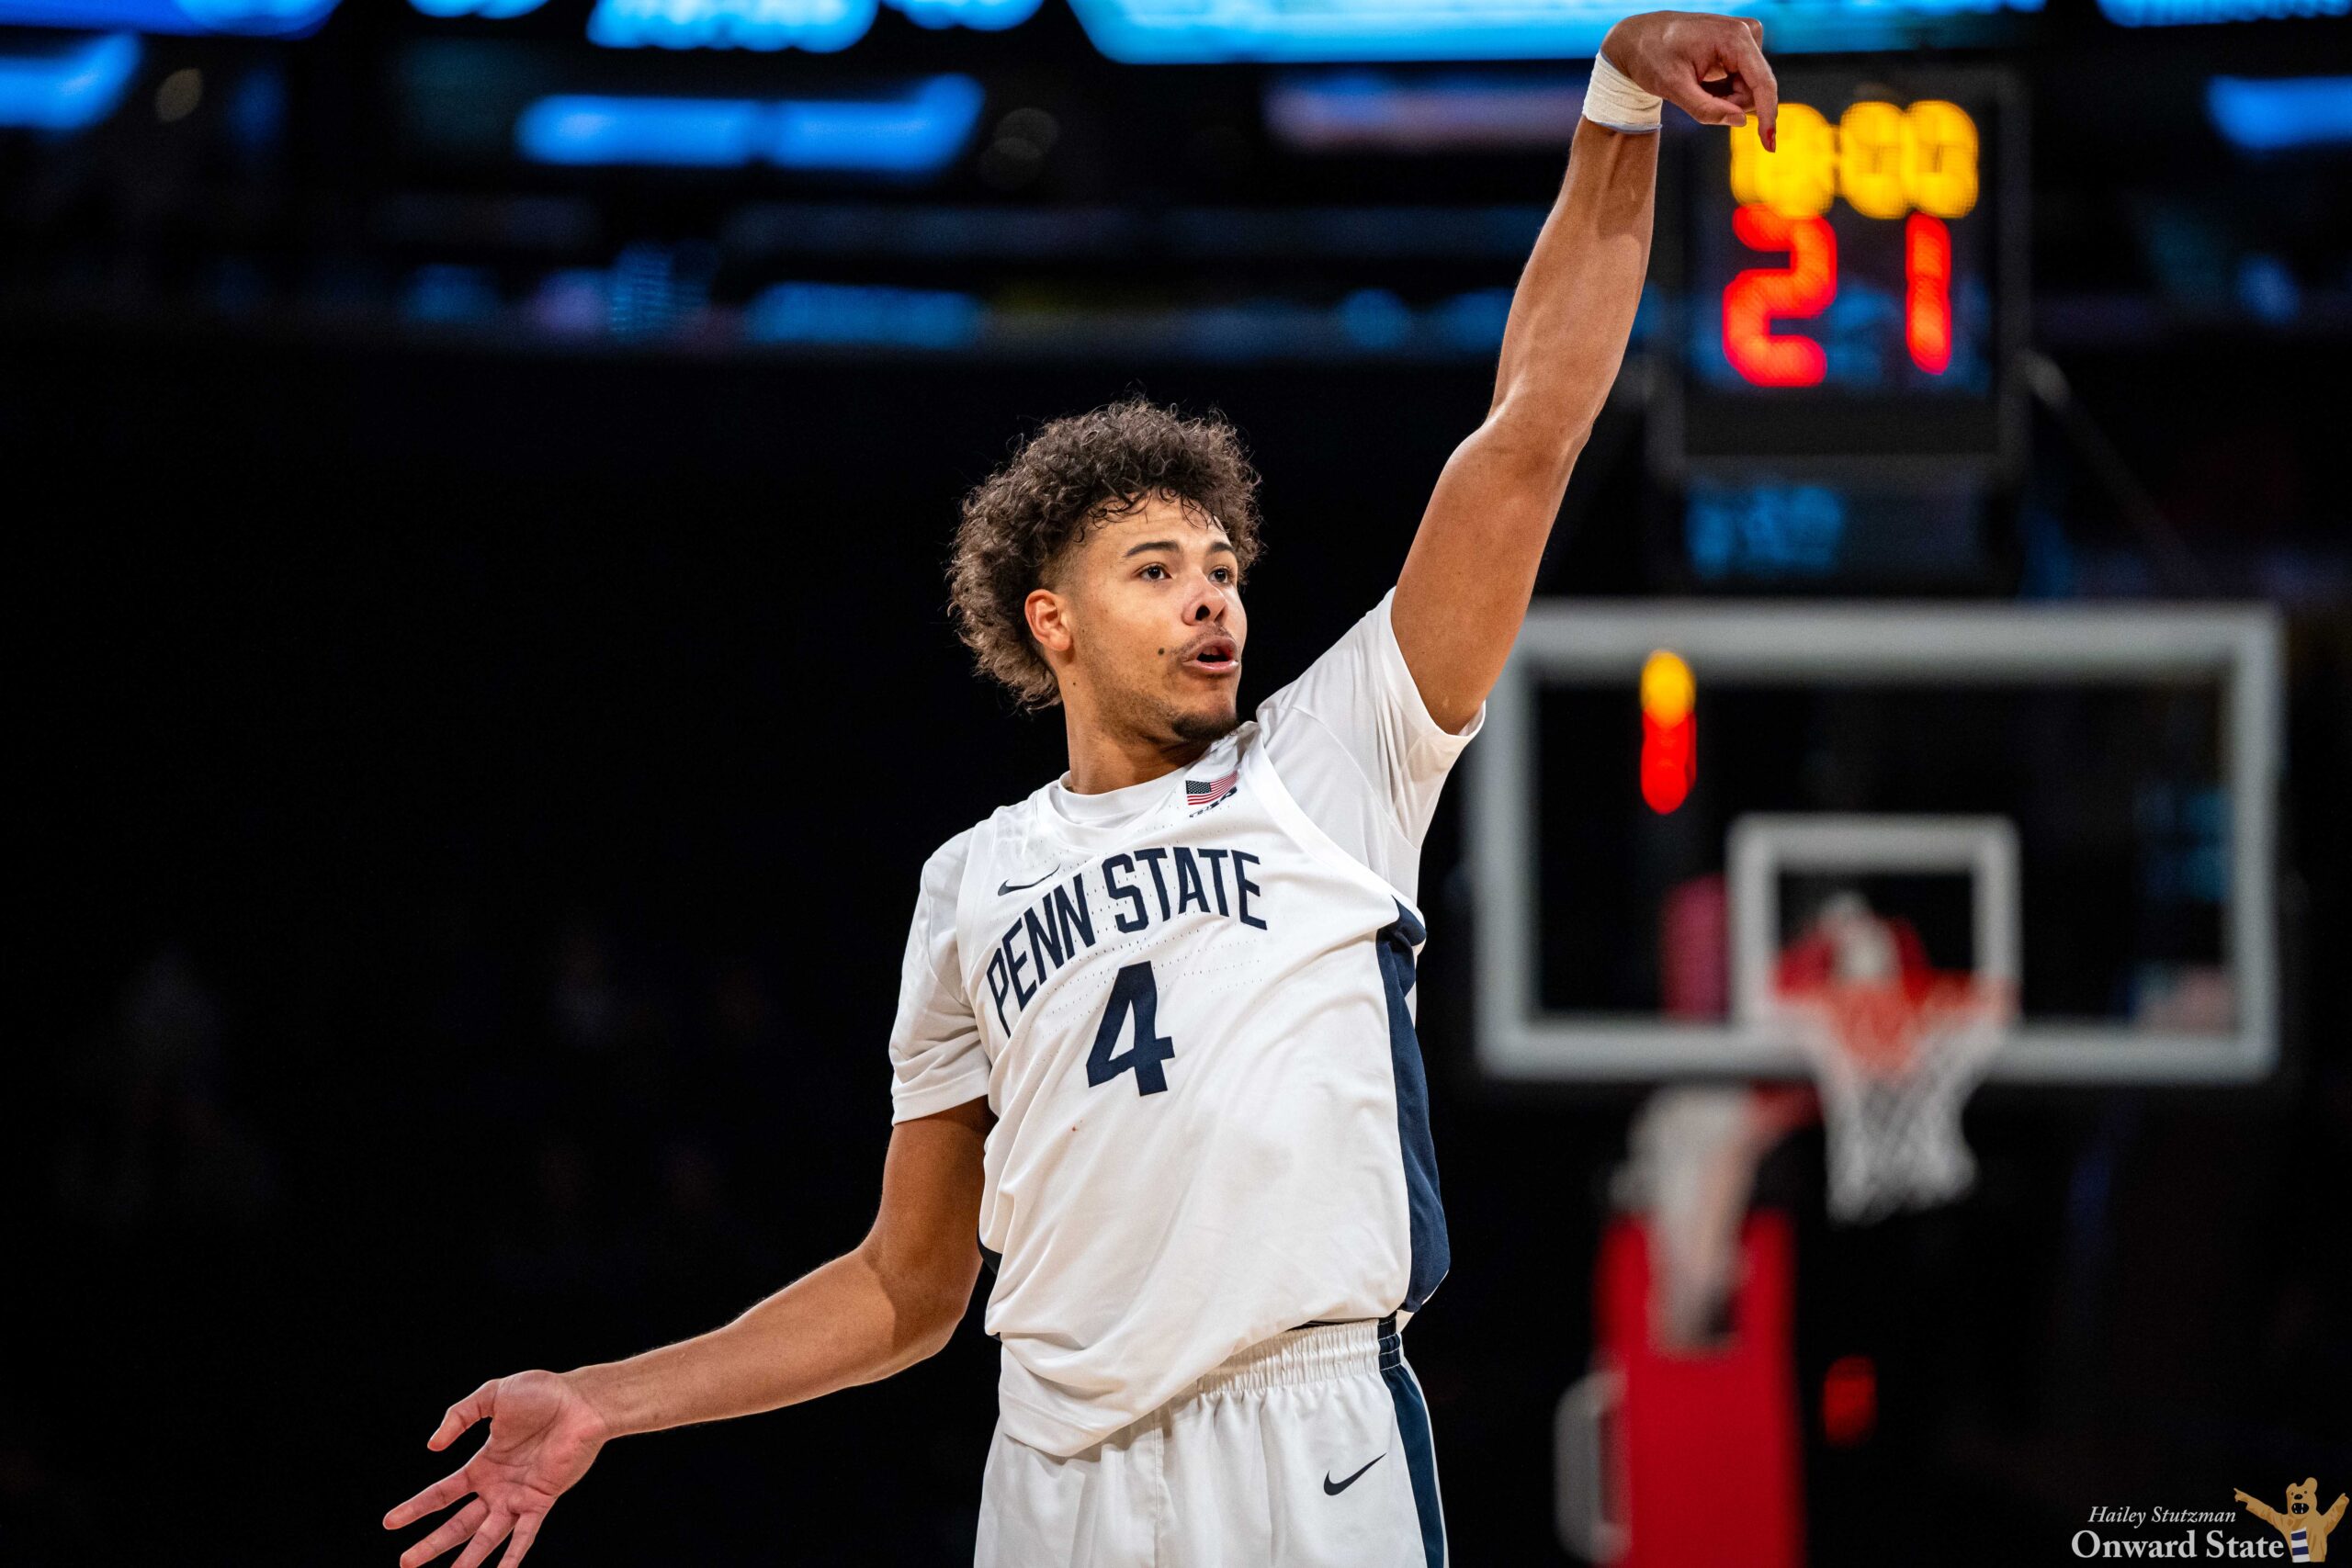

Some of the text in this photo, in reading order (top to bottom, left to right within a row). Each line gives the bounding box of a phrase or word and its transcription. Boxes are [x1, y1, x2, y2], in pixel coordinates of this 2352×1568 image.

[1722, 203, 1952, 388] 21
[987, 847, 1267, 1039] PENN STATE
[1086, 962, 1175, 1096] 4
